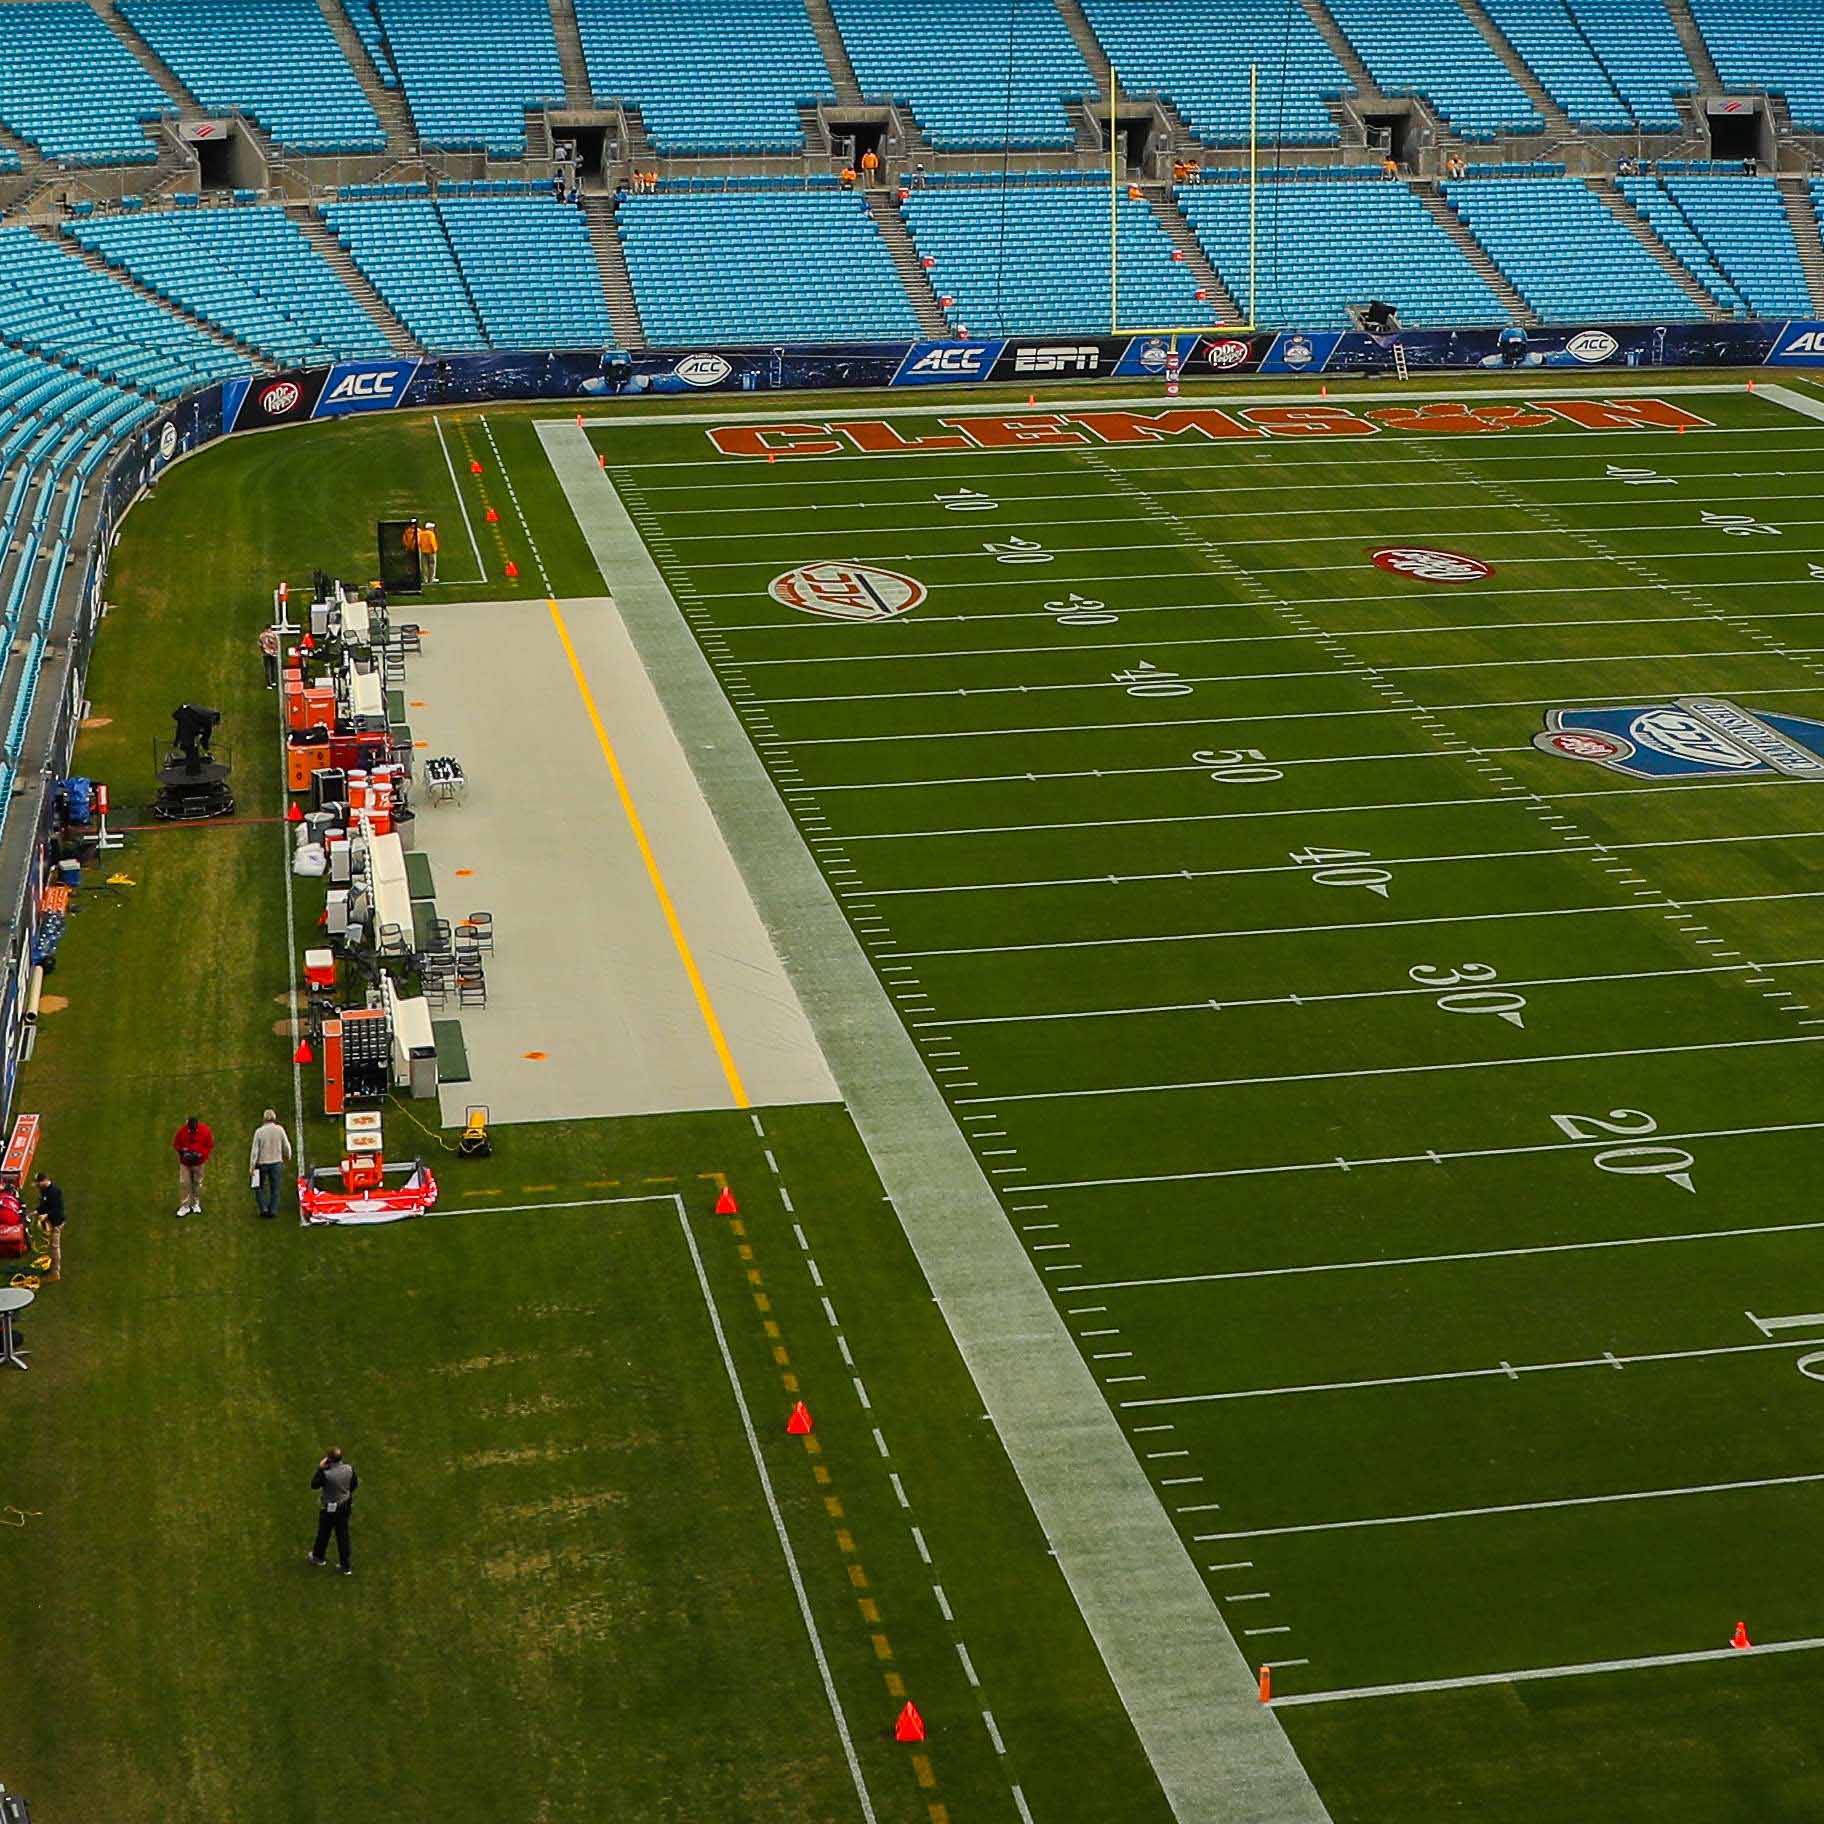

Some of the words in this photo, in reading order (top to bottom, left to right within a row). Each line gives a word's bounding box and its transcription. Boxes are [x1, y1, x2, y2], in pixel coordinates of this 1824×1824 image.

[1575, 339, 1609, 351] ACC
[688, 360, 722, 373] ACC
[913, 348, 986, 370] ACC
[1014, 346, 1101, 372] ESPN
[329, 371, 399, 398] ACC
[1608, 467, 1679, 487] 10
[934, 492, 999, 511] 10
[1702, 512, 1784, 537] 20
[982, 539, 1055, 564] 20
[800, 572, 876, 612] ACC
[1042, 599, 1119, 626] 30
[1110, 667, 1194, 697] 40
[1663, 719, 1749, 764] ACC
[1191, 747, 1284, 784] 50
[1289, 845, 1393, 888] 40
[1407, 962, 1527, 1015] 30
[1549, 1107, 1696, 1175] 20
